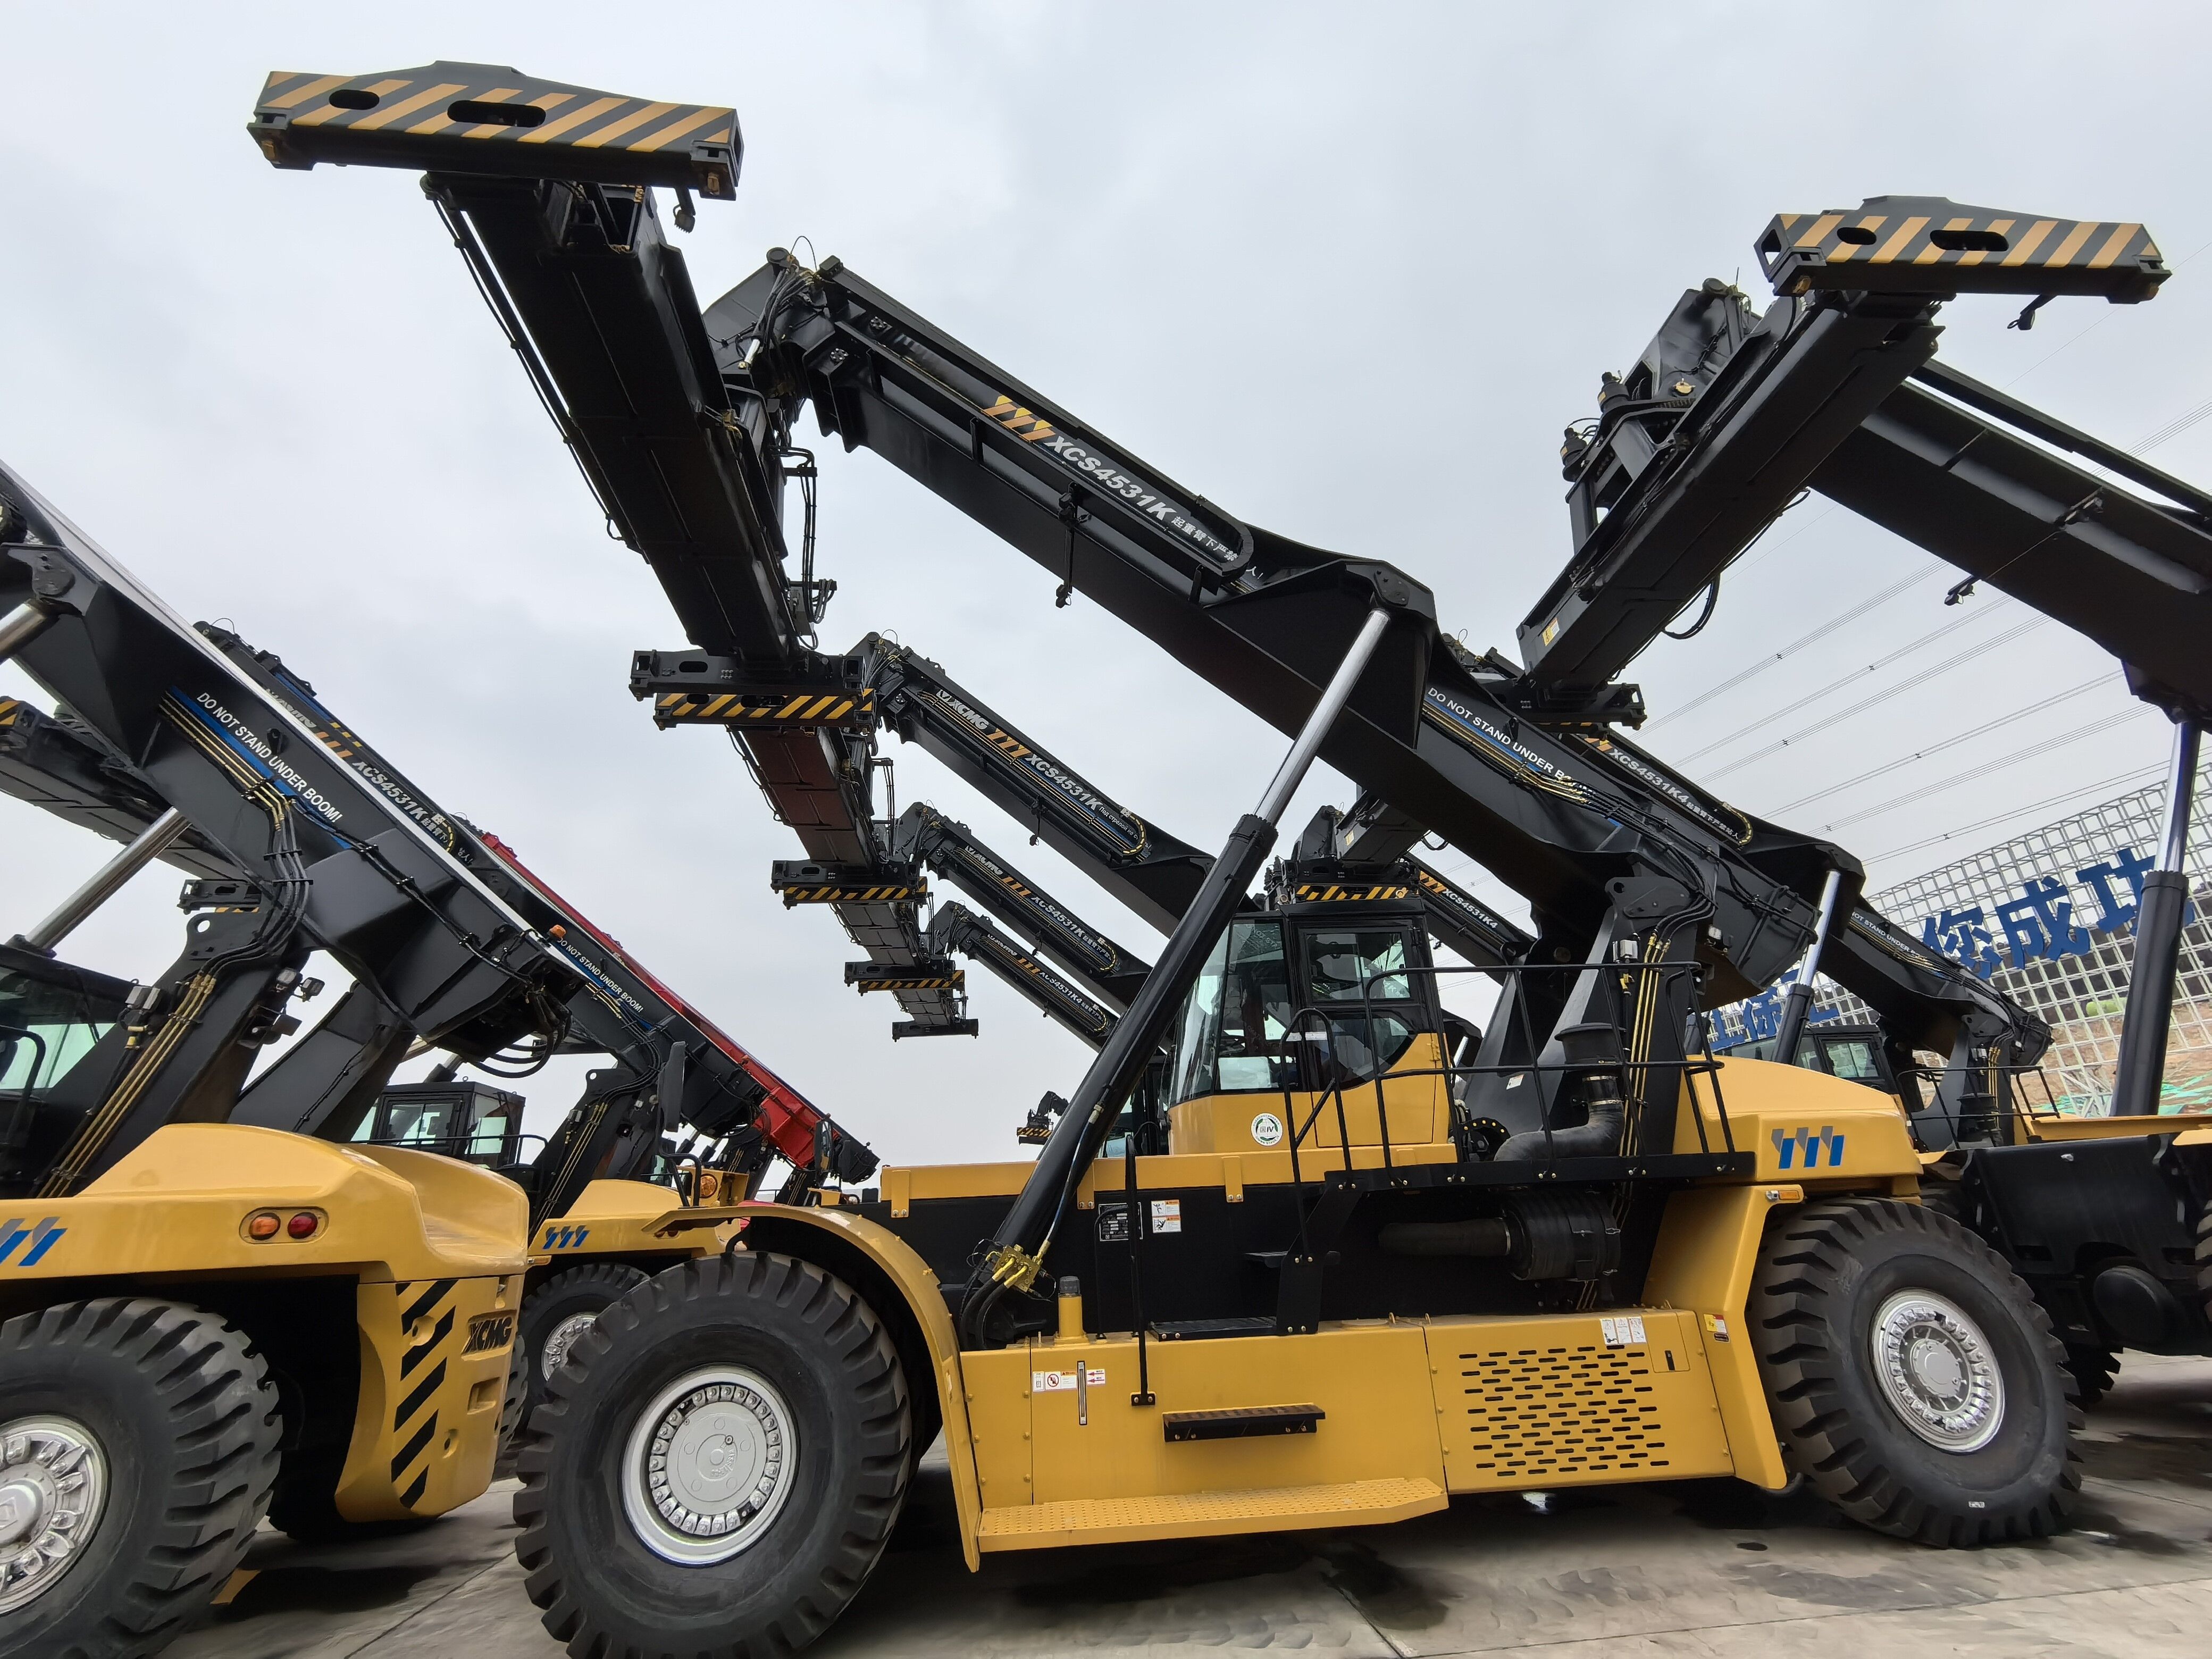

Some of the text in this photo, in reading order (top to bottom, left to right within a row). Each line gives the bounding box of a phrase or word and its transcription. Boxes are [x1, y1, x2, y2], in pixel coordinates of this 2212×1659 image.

[1044, 436, 1176, 521] XCS4531K
[946, 699, 988, 730] XCMG
[1428, 688, 1554, 773] DO NOT STAND UNDER
[197, 692, 342, 823] DO NOT STAND UNDER BOOM!
[1024, 753, 1103, 810] XCS4531K
[1608, 749, 1689, 803] XCS4531K4
[352, 761, 428, 820] XCS4531K
[1099, 806, 1110, 817] Под
[1442, 888, 1498, 928] XCS4531K4
[1864, 920, 1886, 936] STAND
[1887, 935, 1910, 952] UNDER
[566, 945, 581, 958] NOT
[579, 956, 601, 976] STAND
[599, 974, 622, 995] UNDER
[621, 992, 644, 1013] BOOM!
[461, 1317, 513, 1355] XCMG
